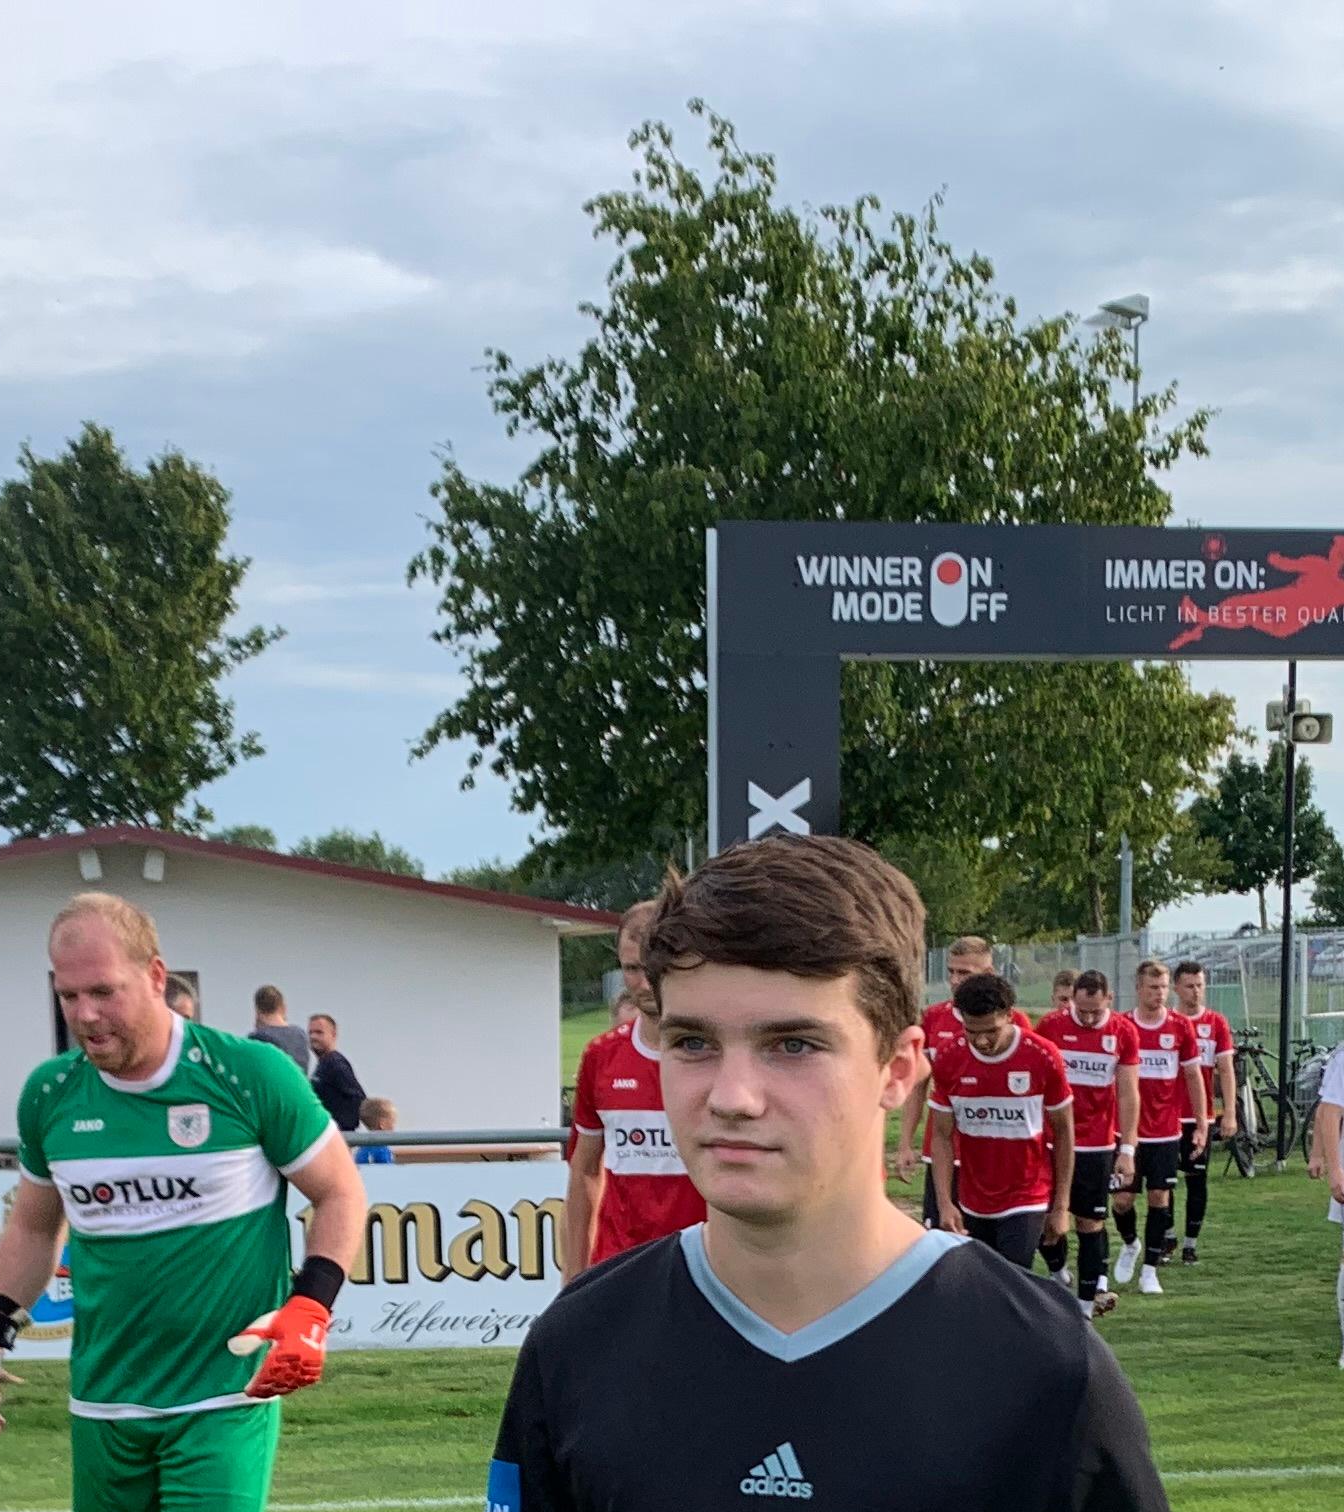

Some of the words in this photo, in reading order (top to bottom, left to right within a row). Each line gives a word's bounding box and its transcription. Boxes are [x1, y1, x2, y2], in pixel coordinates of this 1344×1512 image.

[796, 556, 923, 587] WINNER
[1105, 558, 1206, 590] IMMER
[1214, 558, 1266, 590] ON:
[832, 591, 923, 622] MODE
[1106, 605, 1166, 623] LICHT
[1177, 605, 1198, 624] IN
[1208, 605, 1288, 623] BESTER
[612, 1078, 638, 1089] JAKO
[72, 1118, 105, 1133] JAKO
[964, 1107, 1025, 1120] DOTLUX
[70, 1177, 202, 1205] DOTLUX
[370, 1300, 538, 1344] Hefeweizen
[740, 1477, 813, 1500] adidas
